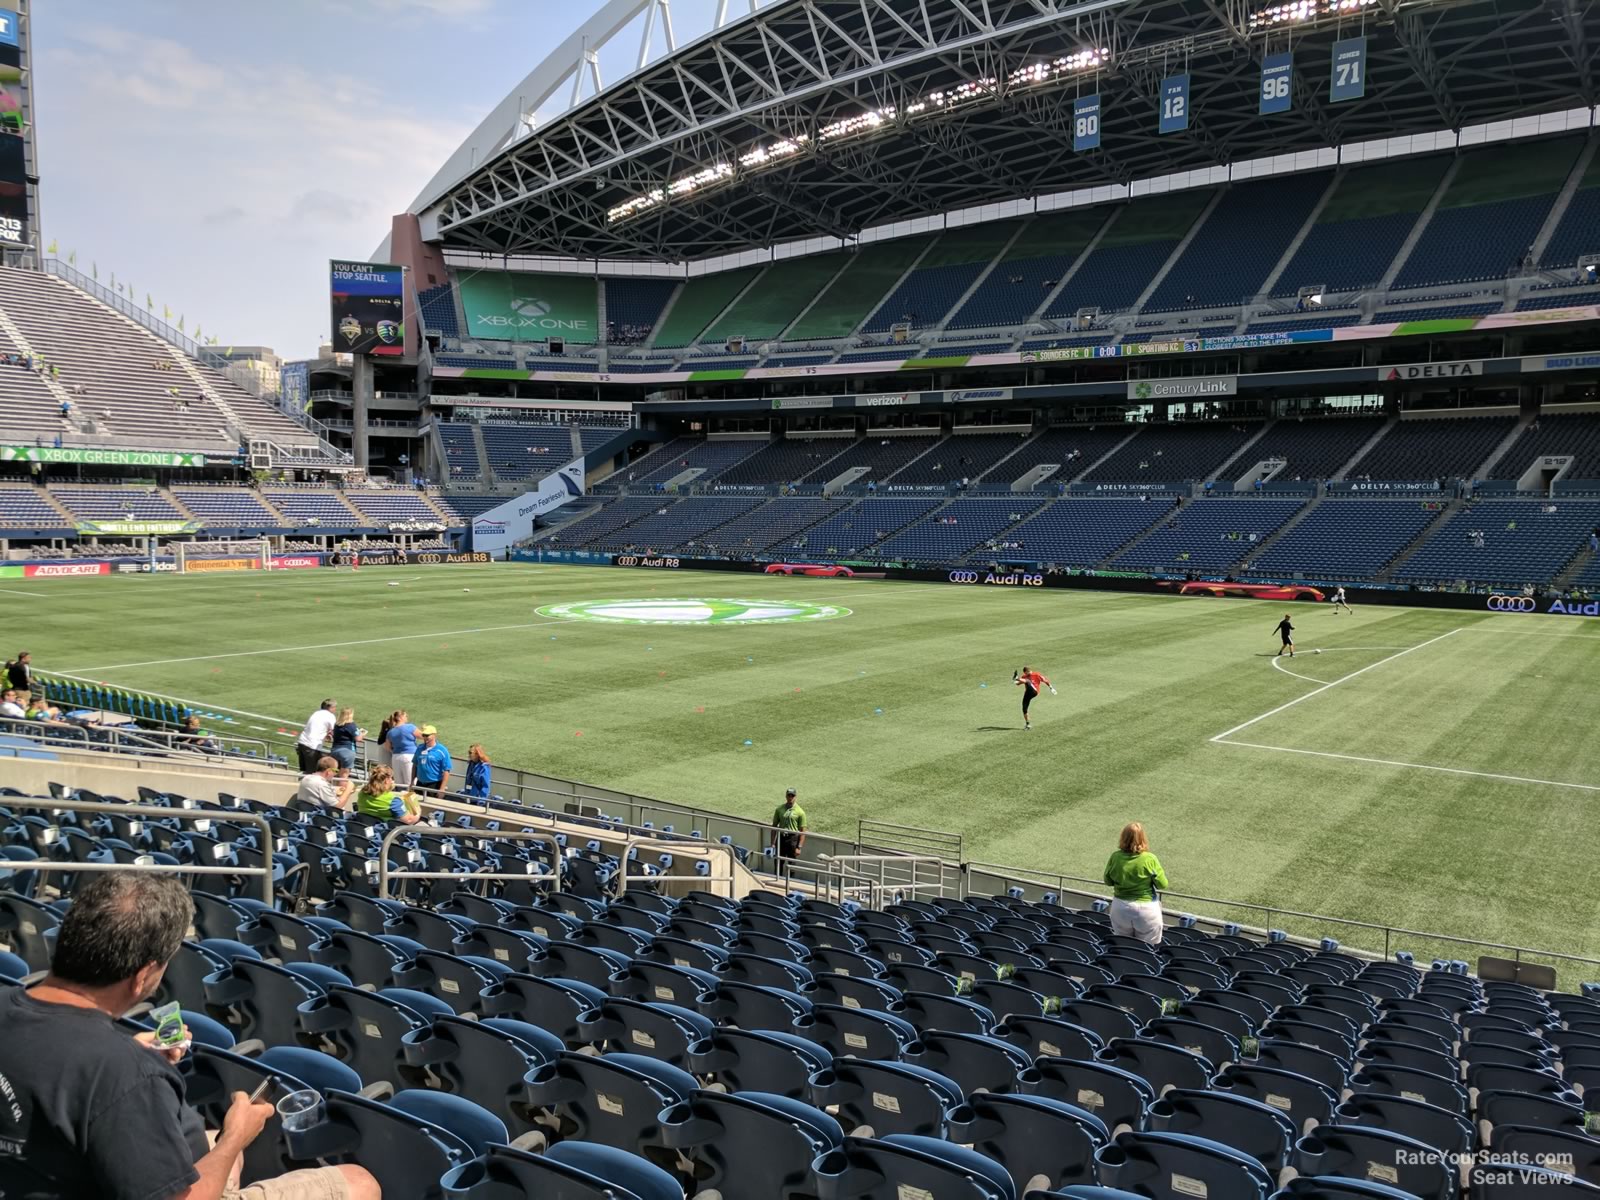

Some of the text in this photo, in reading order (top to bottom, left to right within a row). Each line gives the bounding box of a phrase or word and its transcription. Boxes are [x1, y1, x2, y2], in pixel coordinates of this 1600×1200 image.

[1338, 50, 1360, 60] JONES
[1336, 61, 1360, 87] 71
[1168, 86, 1182, 94] FAN
[1263, 76, 1289, 100] 96
[1164, 96, 1185, 119] 12
[1076, 115, 1098, 137] 80
[334, 263, 374, 273] YOU CAN'T
[333, 271, 388, 283] STOP SEATTLE.
[477, 314, 589, 330] XBOX ONE
[364, 327, 375, 335] VS
[1039, 349, 1070, 361] SOUNDERS
[1070, 348, 1079, 358] FC
[1099, 346, 1116, 357] 0:00
[1137, 343, 1169, 354] SPORTING
[1169, 342, 1179, 351] KC
[1408, 363, 1473, 378] DELTA
[1154, 380, 1228, 396] CenturyLink
[443, 397, 469, 406] Virginia
[866, 395, 903, 406] verizon
[44, 448, 169, 465] XBOX GREEN ZONE
[518, 489, 566, 517] Dream Fearlessly
[362, 554, 389, 565] Audi
[446, 552, 488, 563] Audi R8
[641, 557, 680, 568] Audi R8
[35, 564, 101, 576] ADVOCARE
[142, 561, 177, 572] aidas
[188, 559, 231, 570] Continental
[984, 573, 1044, 586] Audi R8
